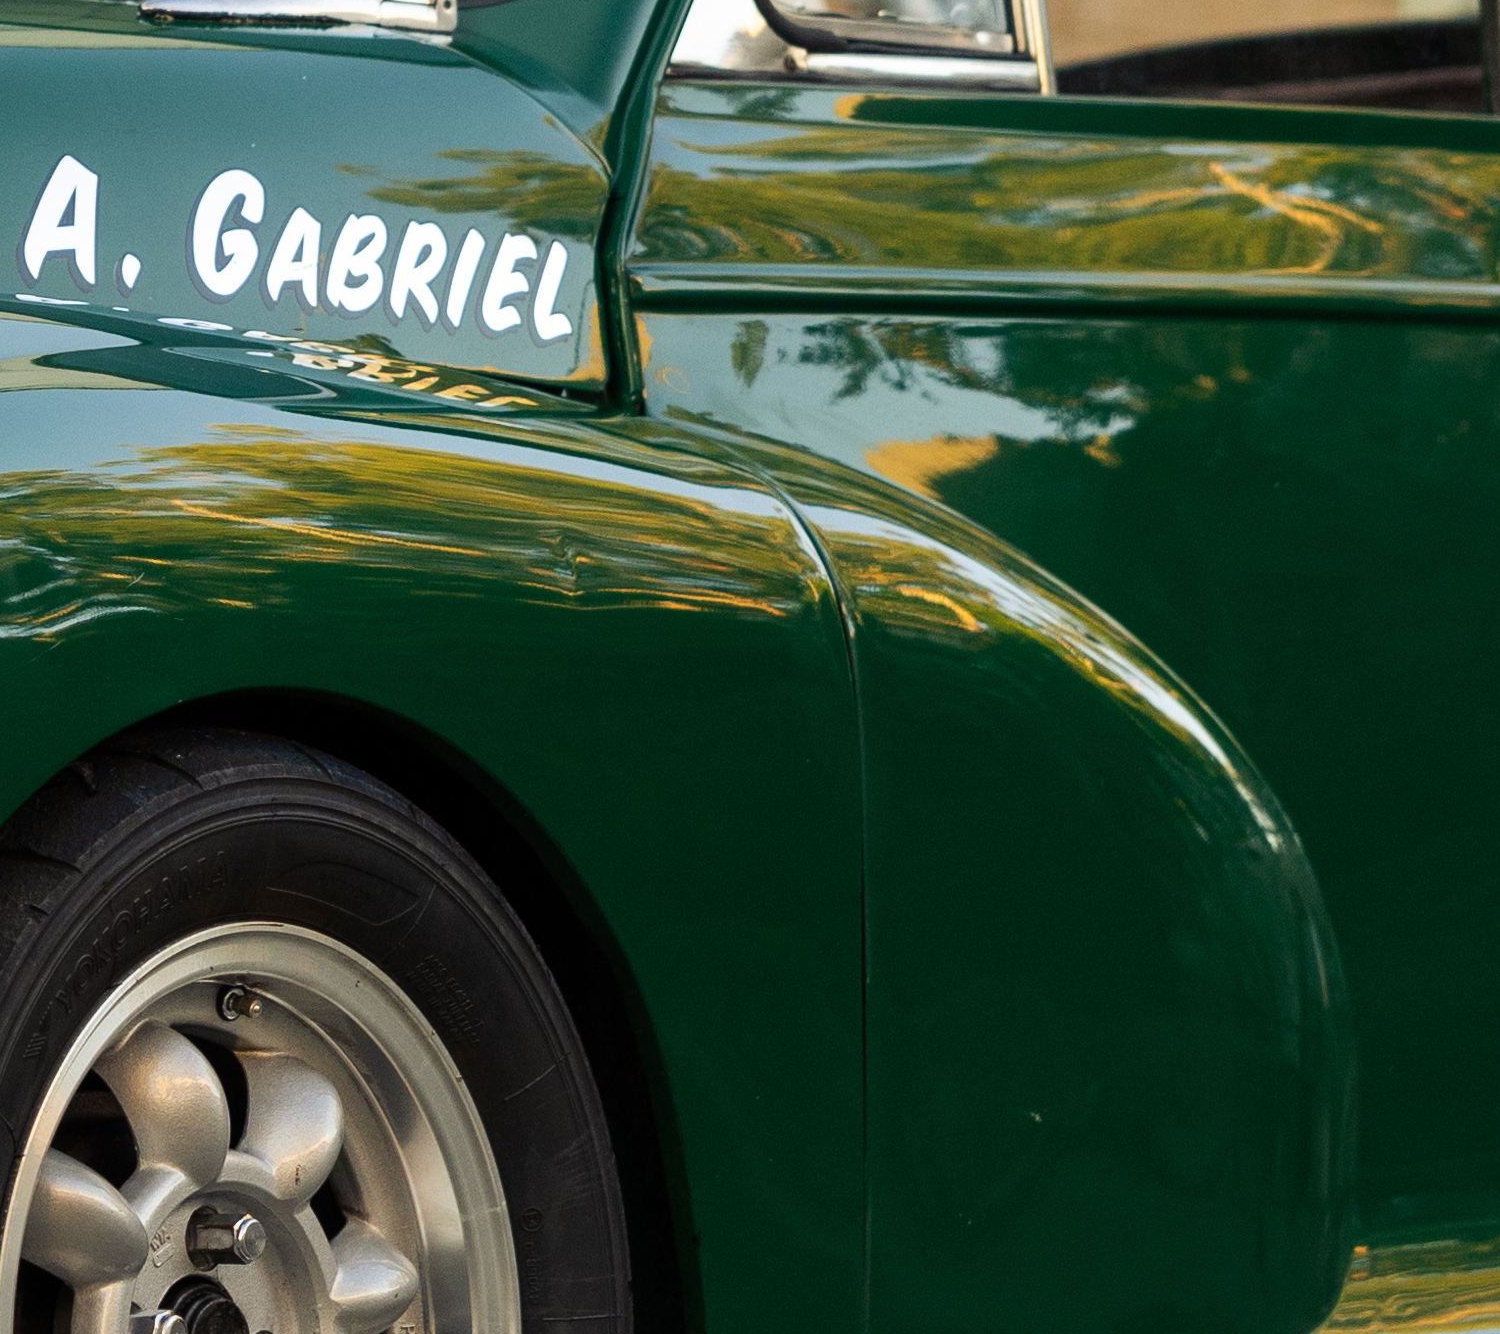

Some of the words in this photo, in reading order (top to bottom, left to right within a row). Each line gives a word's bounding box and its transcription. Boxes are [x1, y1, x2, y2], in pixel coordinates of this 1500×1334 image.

[20, 154, 141, 291] A.
[188, 169, 573, 343] GABRIEL
[55, 849, 230, 1015] YOKOHAMA
